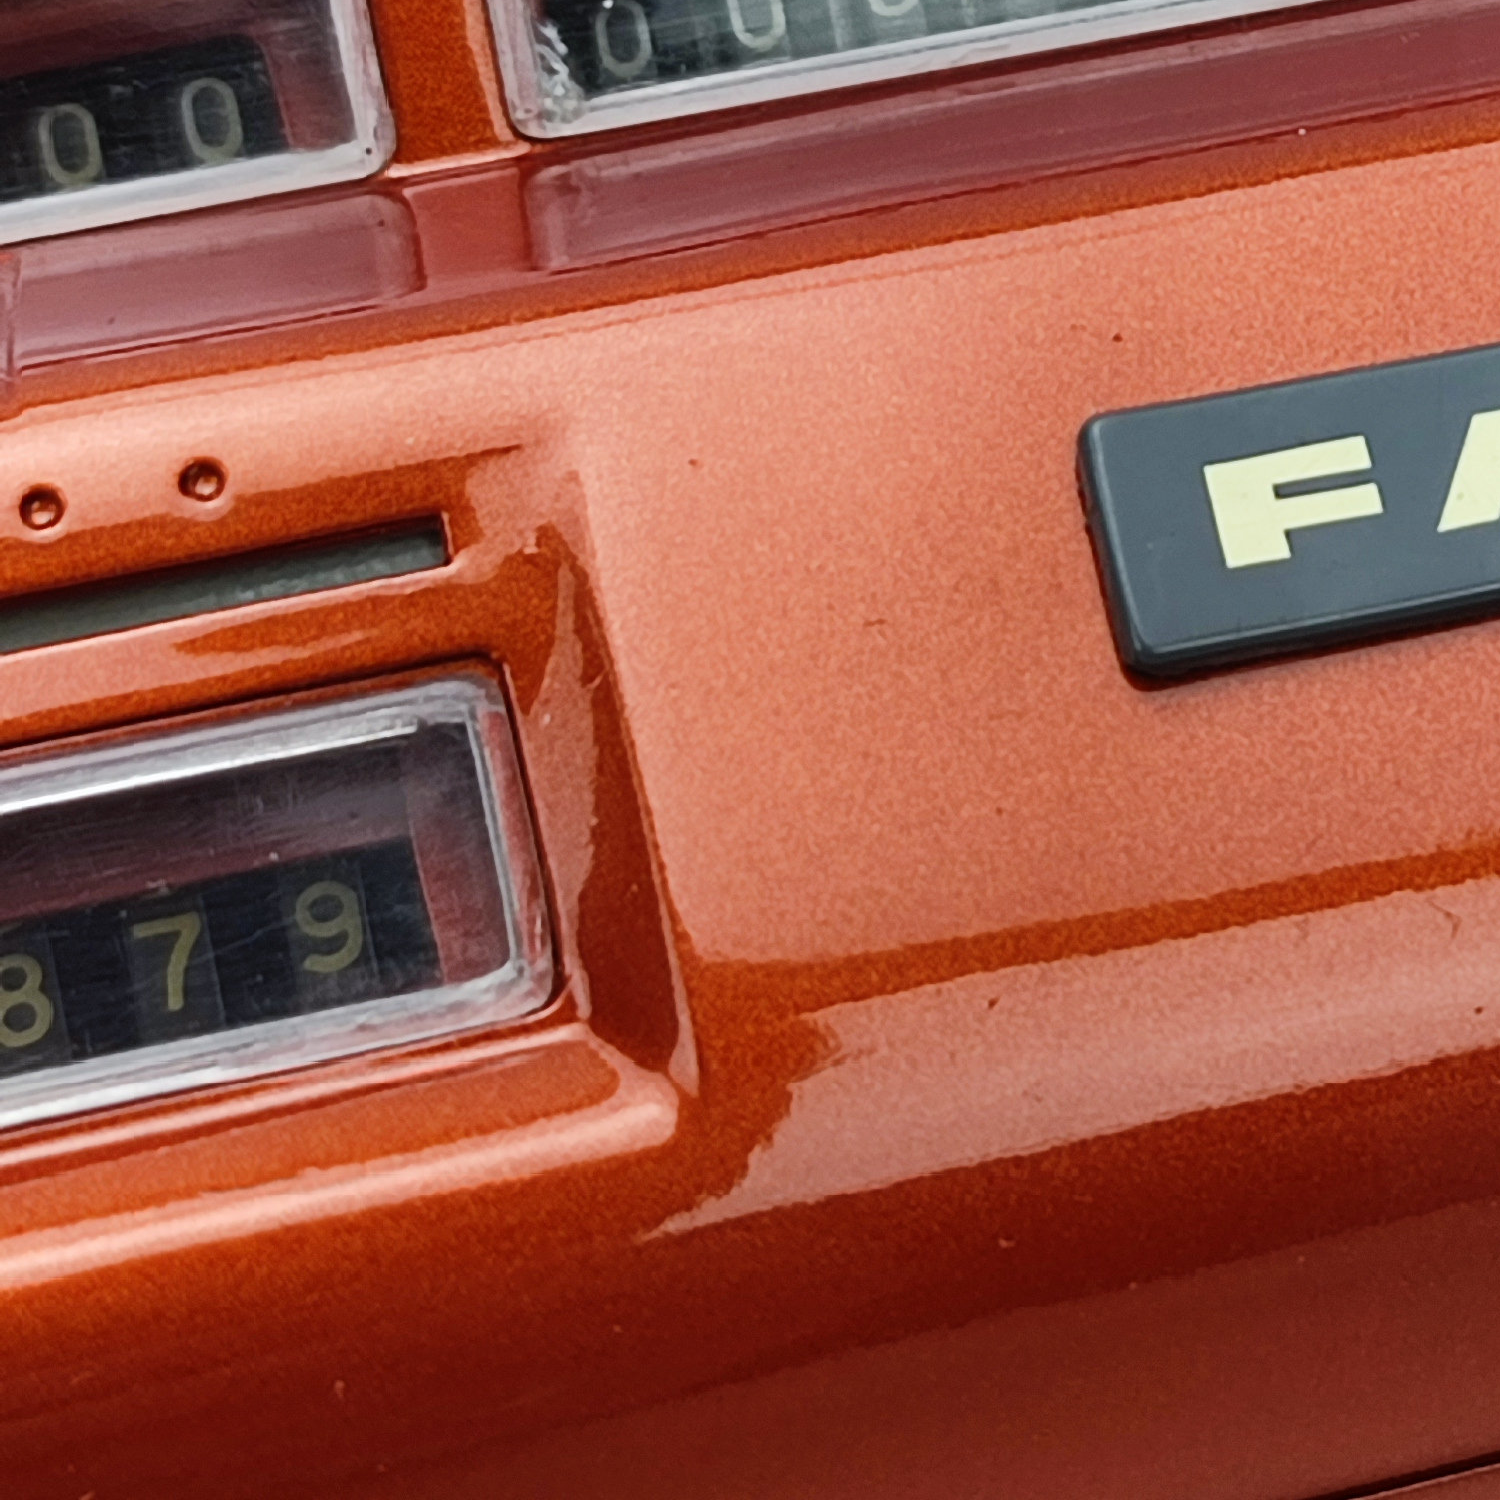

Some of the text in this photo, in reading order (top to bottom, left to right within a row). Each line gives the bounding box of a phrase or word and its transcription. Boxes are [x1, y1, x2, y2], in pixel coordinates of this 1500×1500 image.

[38, 103, 100, 186] 0
[133, 911, 200, 1010] 7
[295, 881, 364, 973] 9
